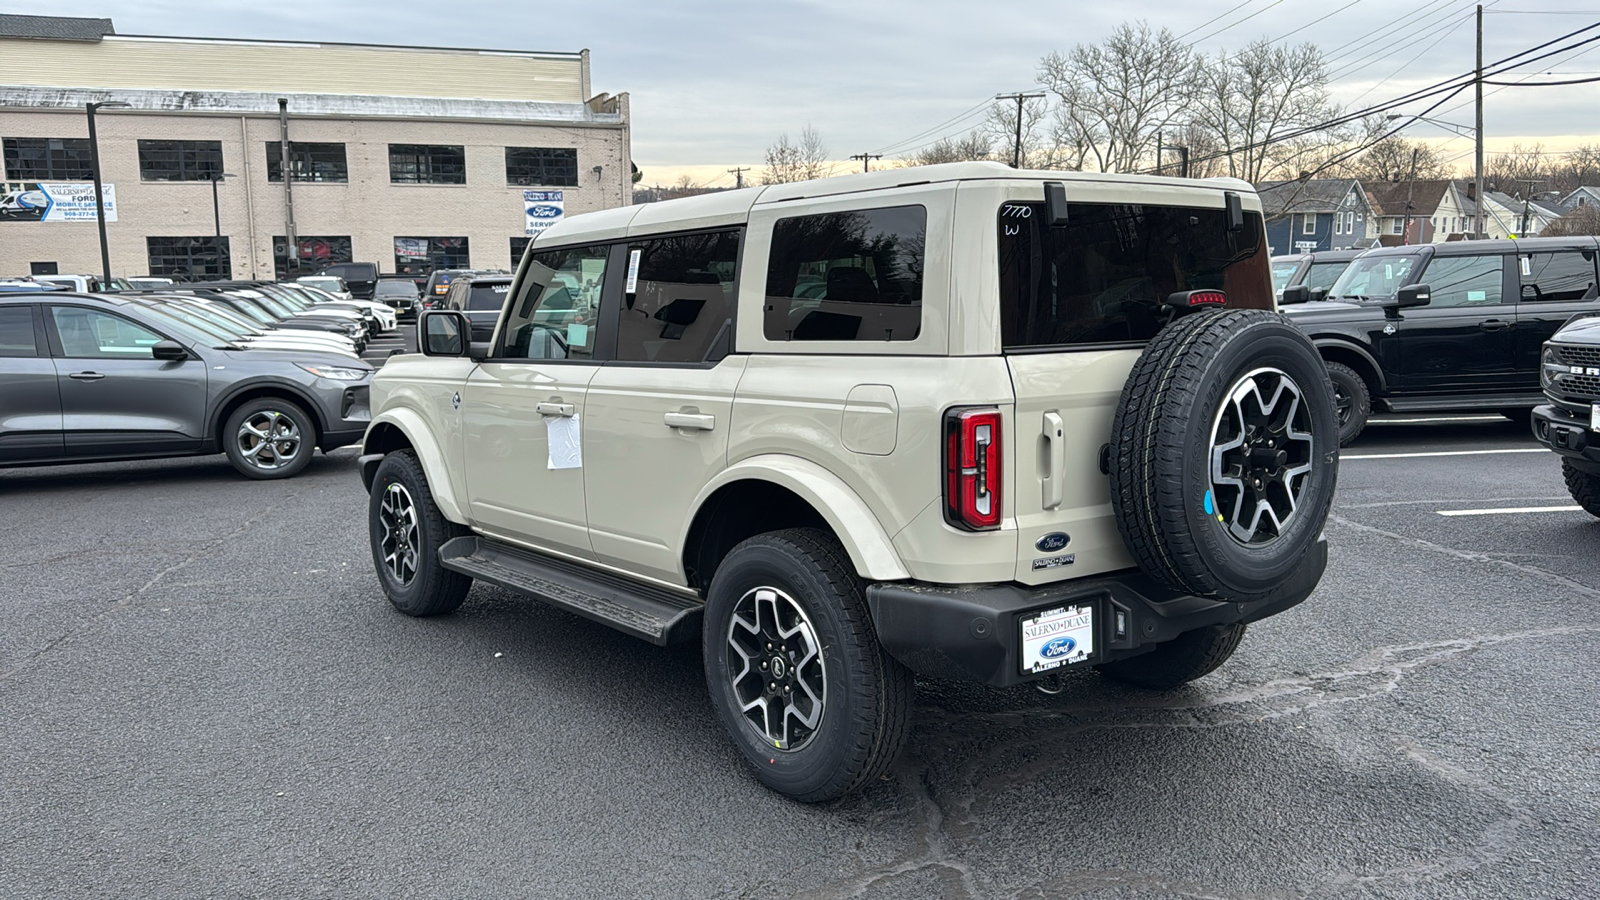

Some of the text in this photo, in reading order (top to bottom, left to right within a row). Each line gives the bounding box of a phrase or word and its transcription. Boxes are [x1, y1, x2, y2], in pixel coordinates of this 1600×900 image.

[533, 207, 556, 216] Ford
[1002, 204, 1032, 218] 7770
[1191, 363, 1228, 565] BRIDGESTONE
[1044, 536, 1065, 549] Ford
[1025, 615, 1090, 638] SALERNO DUANE
[1046, 639, 1070, 656] Ford
[1031, 653, 1088, 673] SALERNO DUANE
